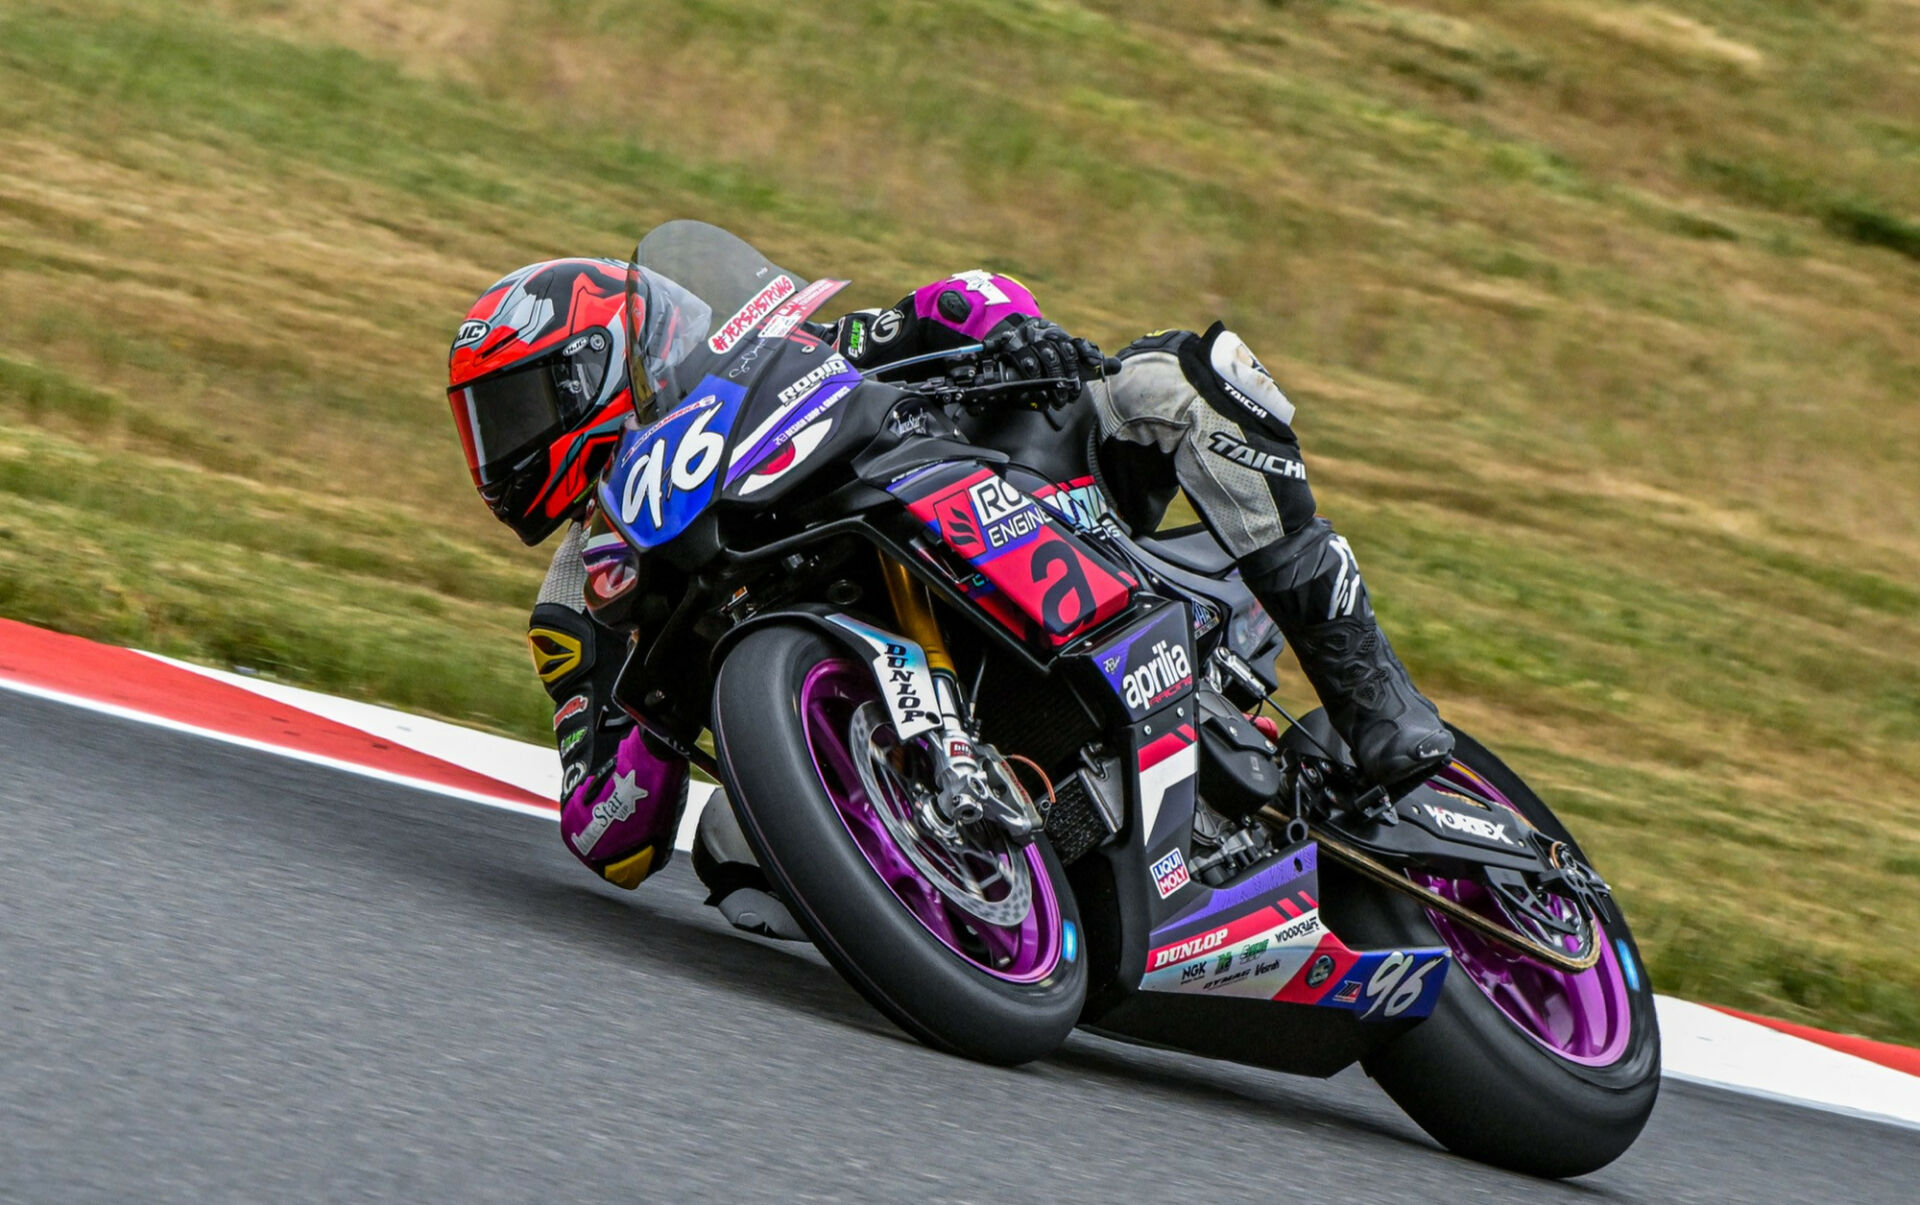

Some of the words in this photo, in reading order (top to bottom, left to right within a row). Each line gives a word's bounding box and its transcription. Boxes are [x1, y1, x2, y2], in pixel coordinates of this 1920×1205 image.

[457, 324, 484, 341] JC
[1224, 382, 1268, 419] TAICHI
[621, 400, 725, 530] 96
[1213, 434, 1306, 480] TAICHI
[884, 642, 926, 724] DUNLOP
[1122, 639, 1192, 711] aprilia
[1423, 803, 1514, 845] VORTEX
[1153, 850, 1183, 880] LIQUI
[1159, 866, 1188, 892] MOLY
[1154, 928, 1229, 968] DUNLOP
[1181, 961, 1207, 980] NGK
[1360, 951, 1445, 1020] 96
